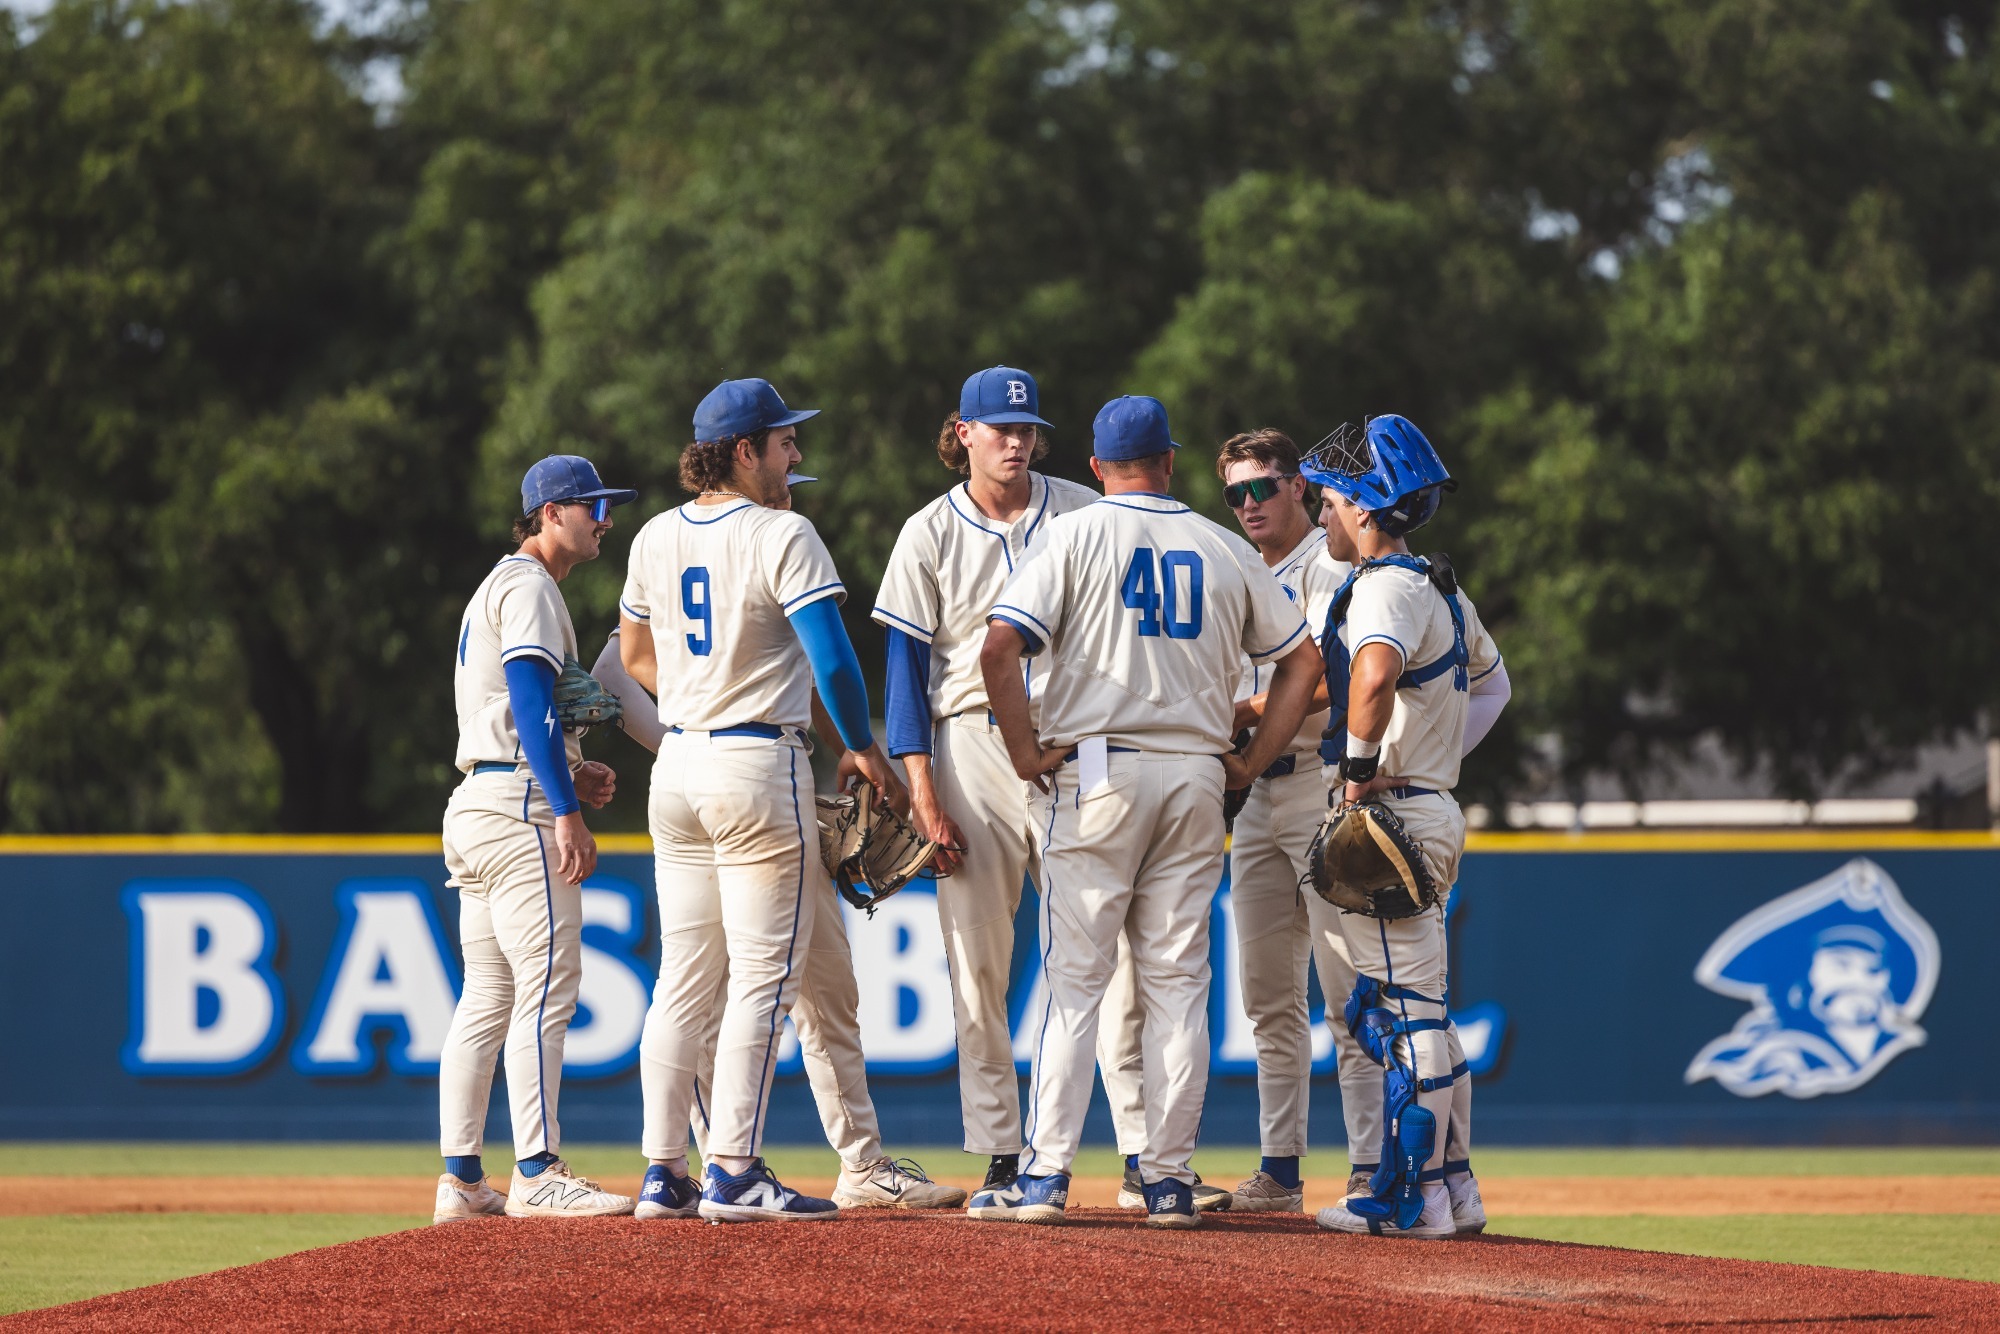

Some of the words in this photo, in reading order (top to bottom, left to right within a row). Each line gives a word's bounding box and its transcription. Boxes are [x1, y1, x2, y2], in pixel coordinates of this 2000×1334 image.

[1006, 380, 1028, 405] B
[681, 566, 712, 656] 9
[1120, 547, 1203, 639] 40
[122, 878, 1503, 1076] BASBL
